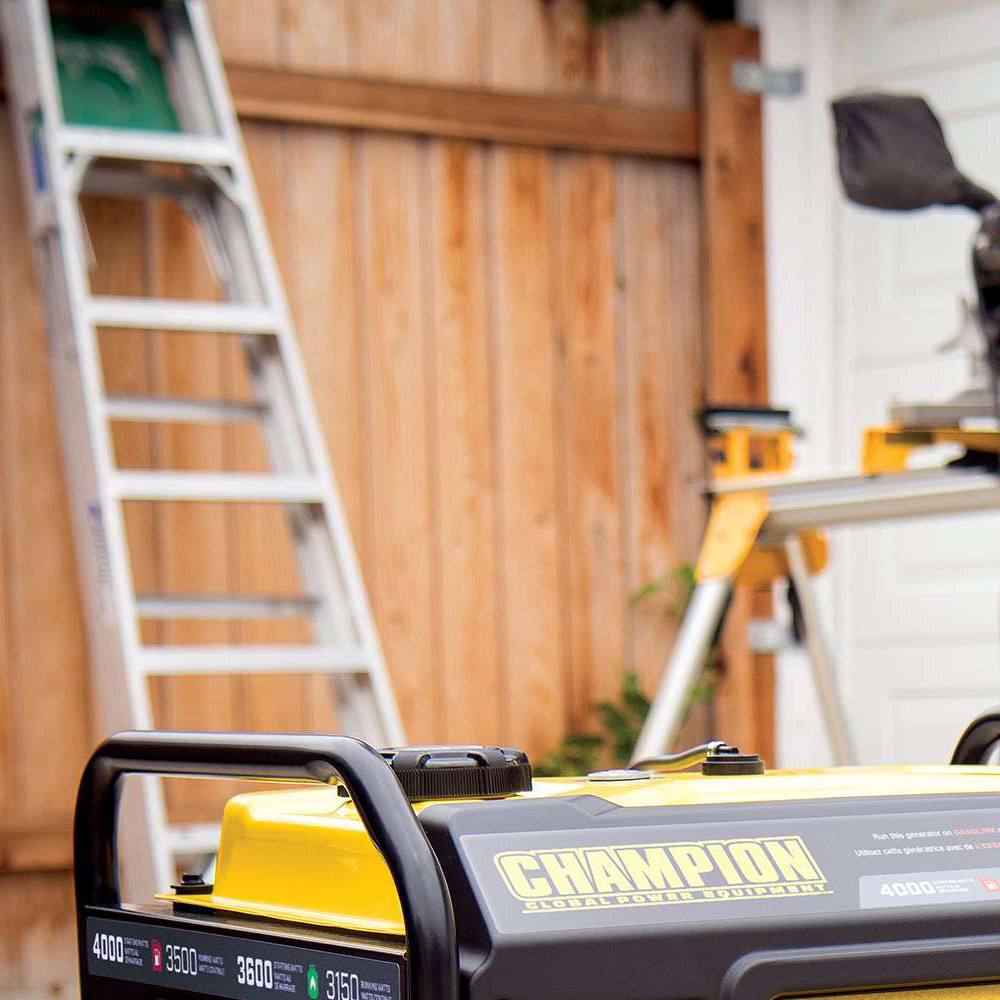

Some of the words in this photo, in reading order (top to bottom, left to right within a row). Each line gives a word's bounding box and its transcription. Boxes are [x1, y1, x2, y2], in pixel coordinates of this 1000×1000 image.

[872, 832, 889, 840] Run
[890, 831, 904, 839] this
[905, 830, 941, 840] generator
[498, 838, 824, 899] CHAMPION
[525, 897, 611, 911] GLOBAL
[617, 892, 693, 905] POWER
[703, 883, 827, 900] EQUIPMENT
[880, 881, 935, 897] 4000
[93, 932, 123, 963] 4000
[166, 944, 198, 976] 3500
[236, 955, 273, 989] 3600
